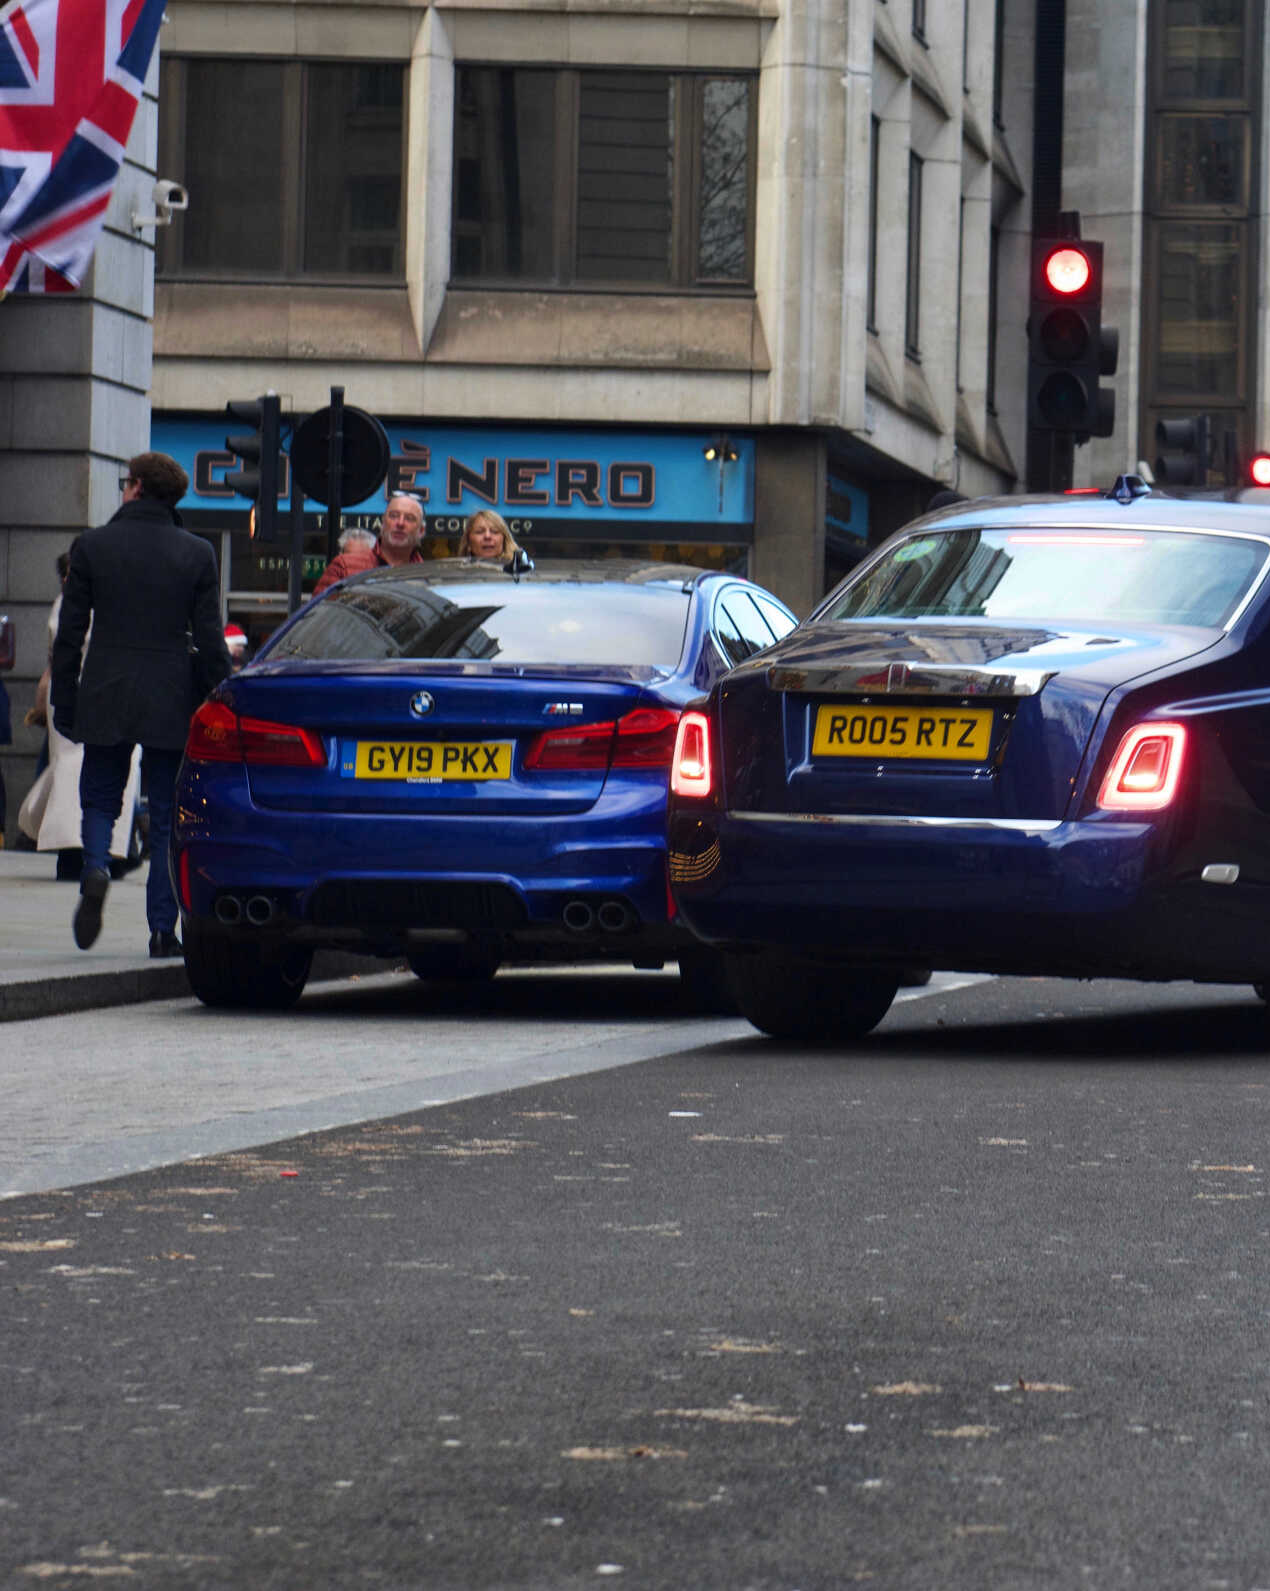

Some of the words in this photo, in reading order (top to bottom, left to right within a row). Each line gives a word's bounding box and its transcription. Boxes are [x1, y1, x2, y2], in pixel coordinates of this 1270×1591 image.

[446, 456, 656, 507] NERO
[316, 515, 347, 529] TE
[916, 716, 978, 748] RTZ
[367, 746, 434, 774] GY19
[442, 746, 501, 774] PKX
